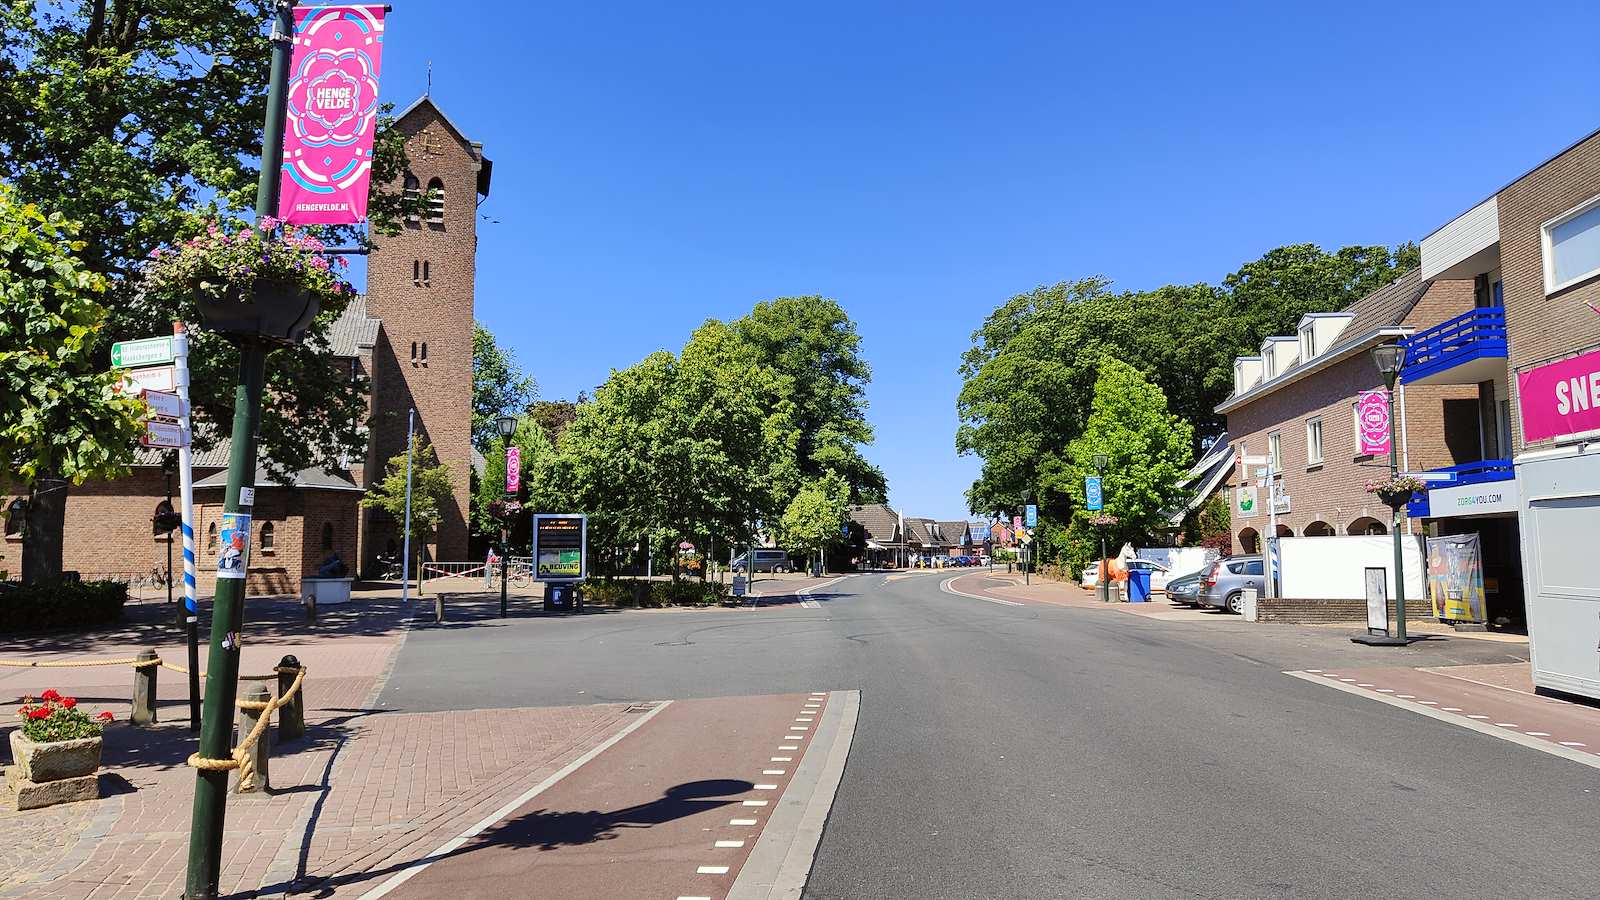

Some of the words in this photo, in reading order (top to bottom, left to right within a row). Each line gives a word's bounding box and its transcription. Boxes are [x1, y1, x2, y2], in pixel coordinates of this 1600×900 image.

[317, 87, 352, 99] HENGE
[317, 98, 350, 110] VELDE
[295, 203, 349, 212] HENGEVELDE.NL
[1555, 371, 1600, 416] SNE
[1457, 493, 1502, 506] ZORG4YOU.COM
